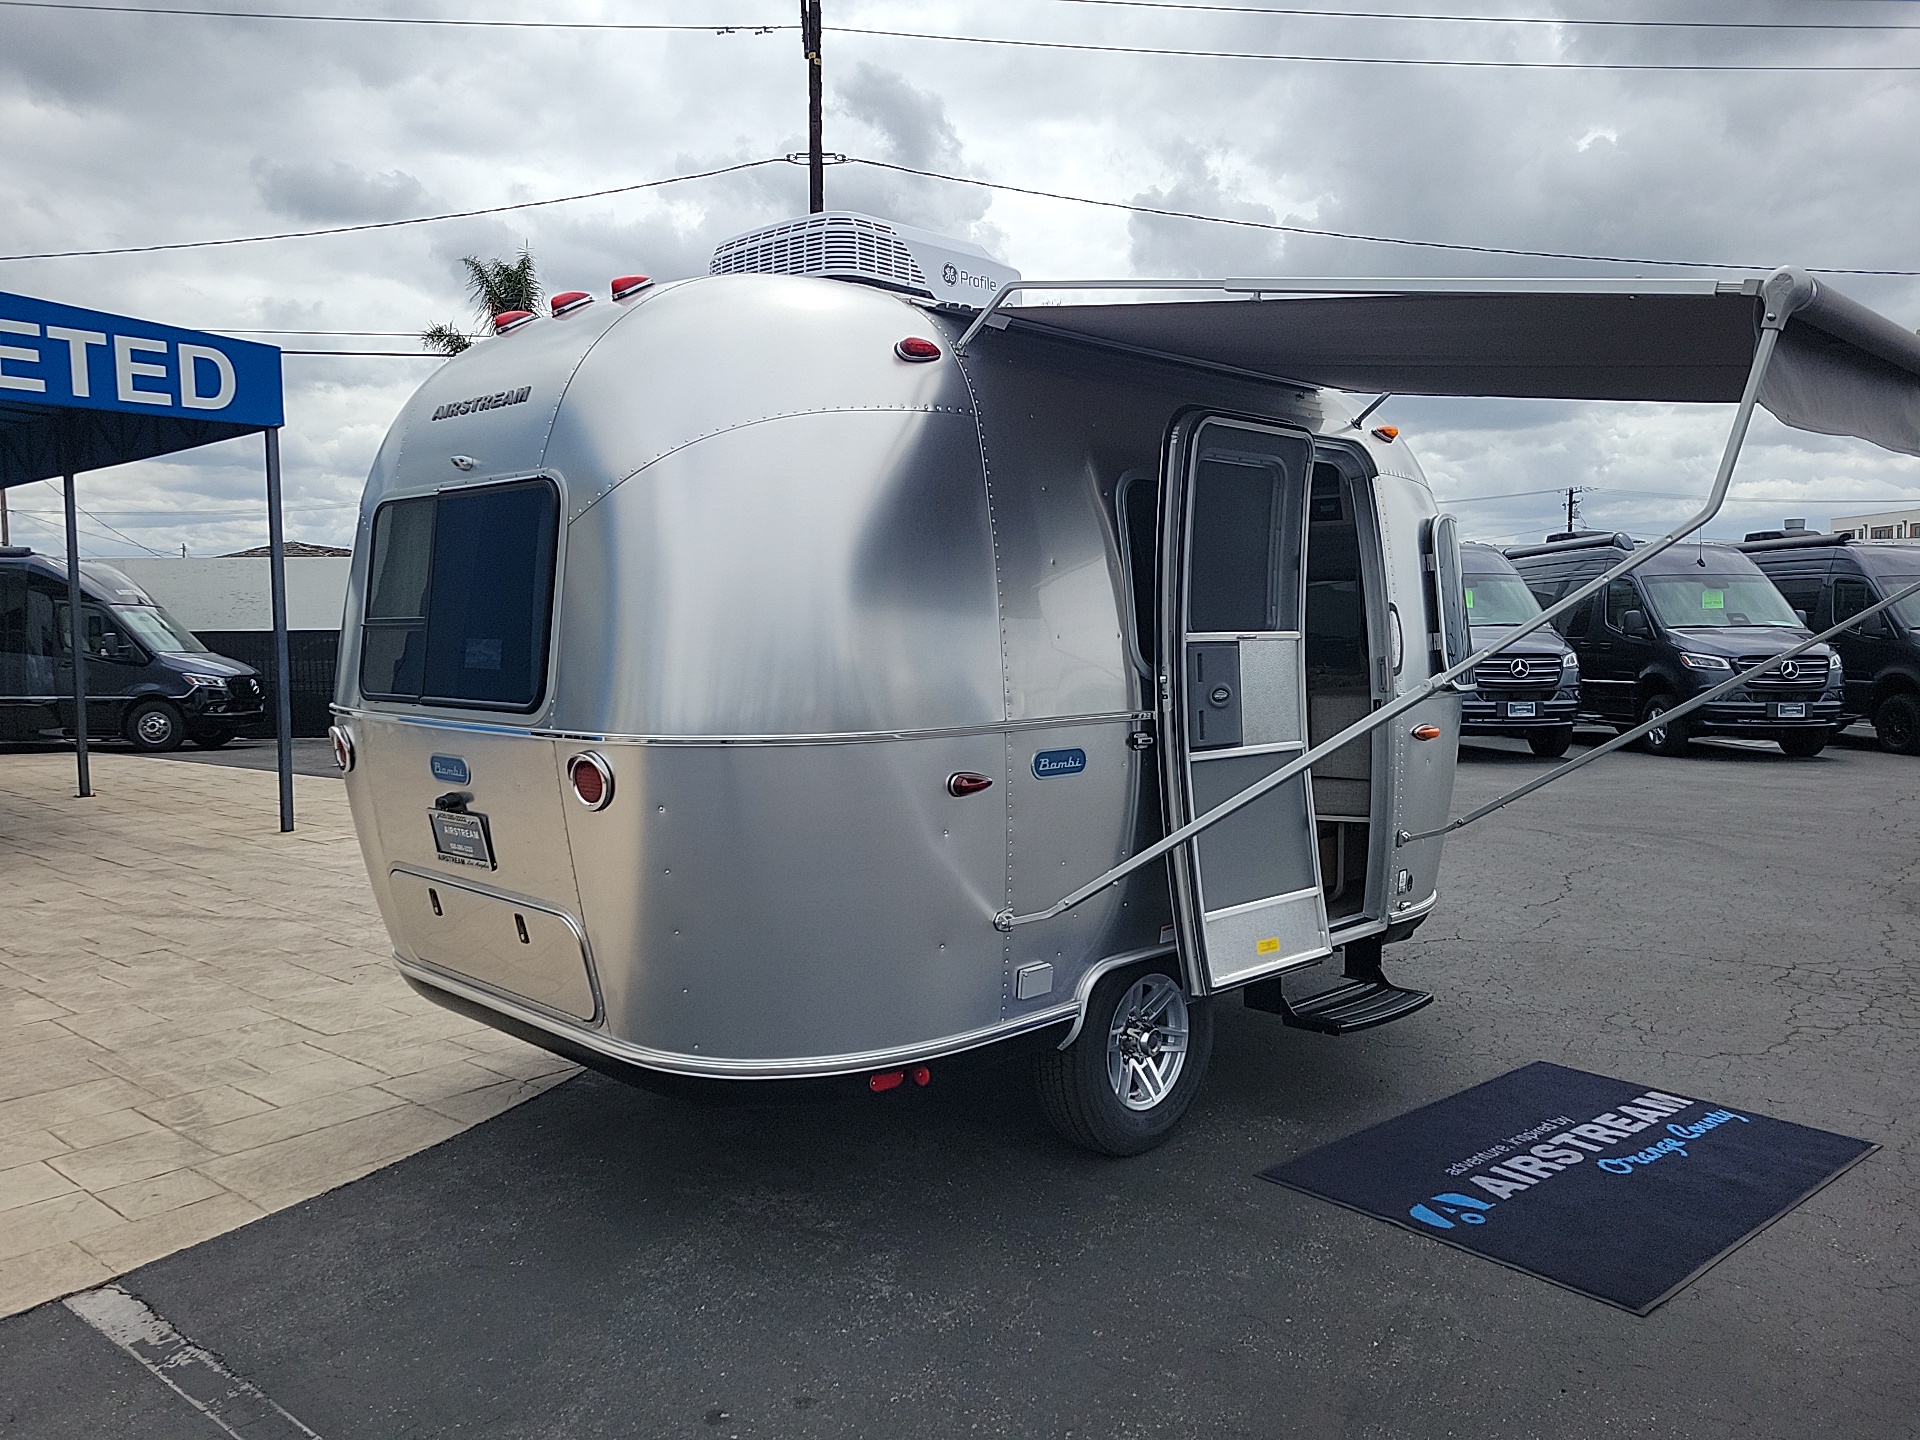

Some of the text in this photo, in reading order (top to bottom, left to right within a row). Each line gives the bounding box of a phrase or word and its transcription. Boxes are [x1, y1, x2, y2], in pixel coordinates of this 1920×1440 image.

[960, 270, 997, 292] Profile
[0, 318, 236, 410] ETED
[431, 385, 532, 421] AIRSTREAM
[433, 761, 466, 777] Bambi
[1038, 756, 1083, 771] Bambi
[444, 825, 480, 840] AIRSTREAM
[437, 854, 466, 866] AIRSTREAM
[1502, 1120, 1559, 1145] inspired
[1546, 1115, 1576, 1127] by
[1597, 1109, 1750, 1174] Orange County
[1469, 1091, 1695, 1200] AIRSTREAM
